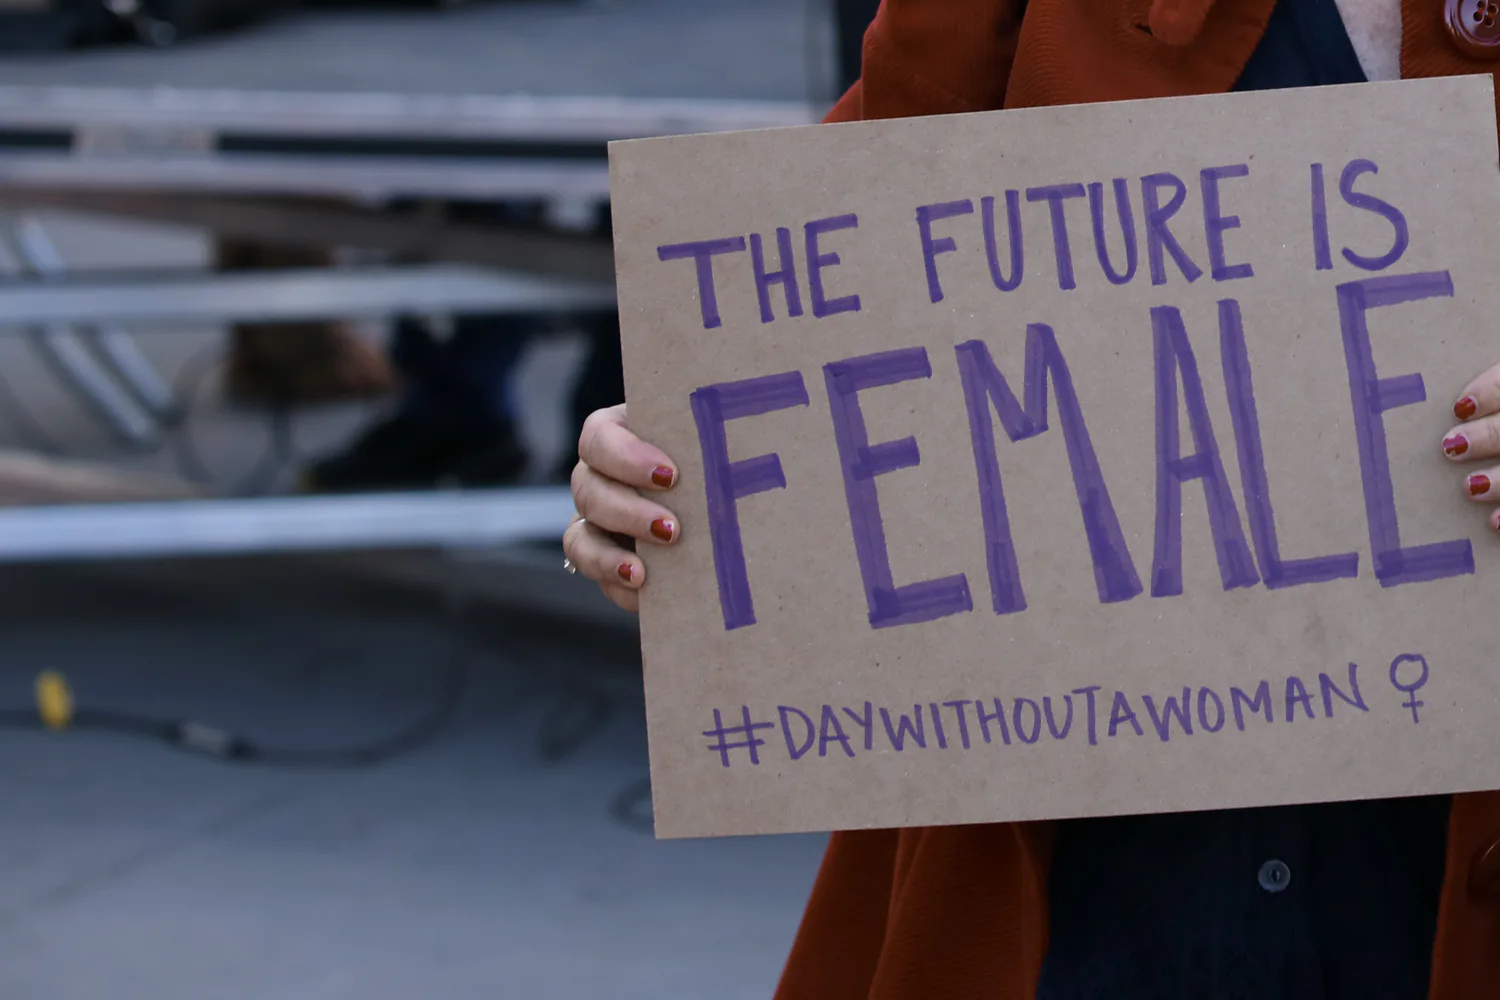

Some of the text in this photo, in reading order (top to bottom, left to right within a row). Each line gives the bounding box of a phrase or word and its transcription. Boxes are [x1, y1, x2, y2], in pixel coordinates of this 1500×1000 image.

[656, 157, 1411, 329] THE FUTURE IS
[690, 270, 1476, 632] FEMALE
[702, 662, 1370, 767] #DAYWITHOUTAWOMAN
